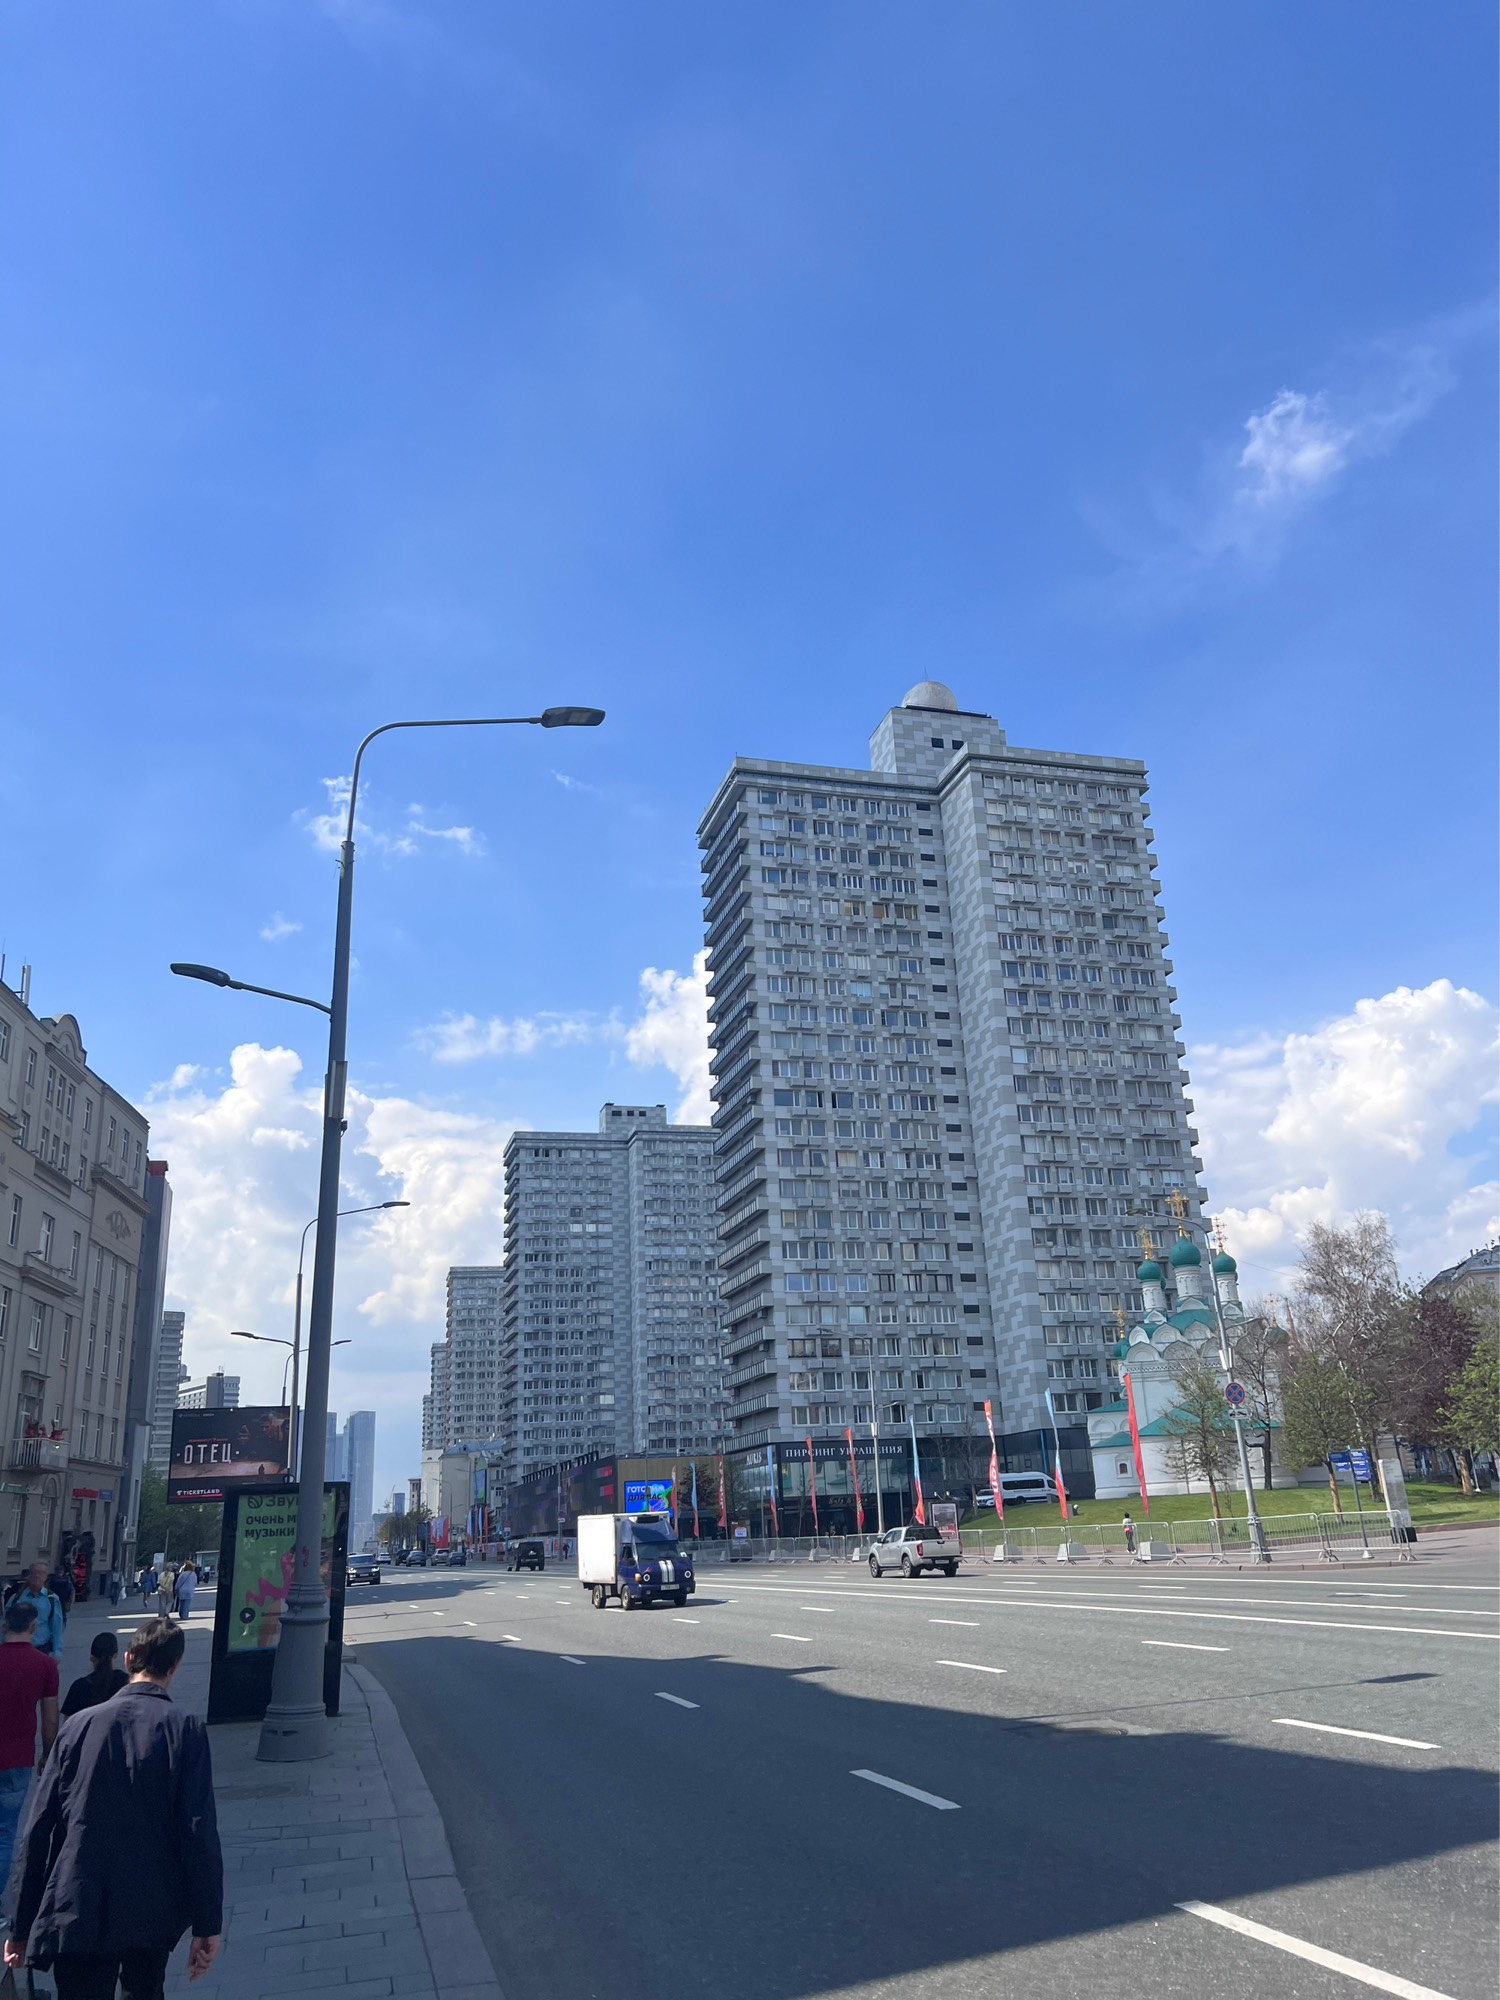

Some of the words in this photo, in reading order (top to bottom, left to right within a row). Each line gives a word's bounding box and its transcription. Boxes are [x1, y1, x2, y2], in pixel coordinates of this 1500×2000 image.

[184, 1443, 232, 1464] ОТЕЦ
[785, 1447, 836, 1458] ПИРСИНГ
[183, 1488, 220, 1496] TICKETLAND
[246, 1515, 284, 1525] очень
[245, 1527, 295, 1540] музыки
